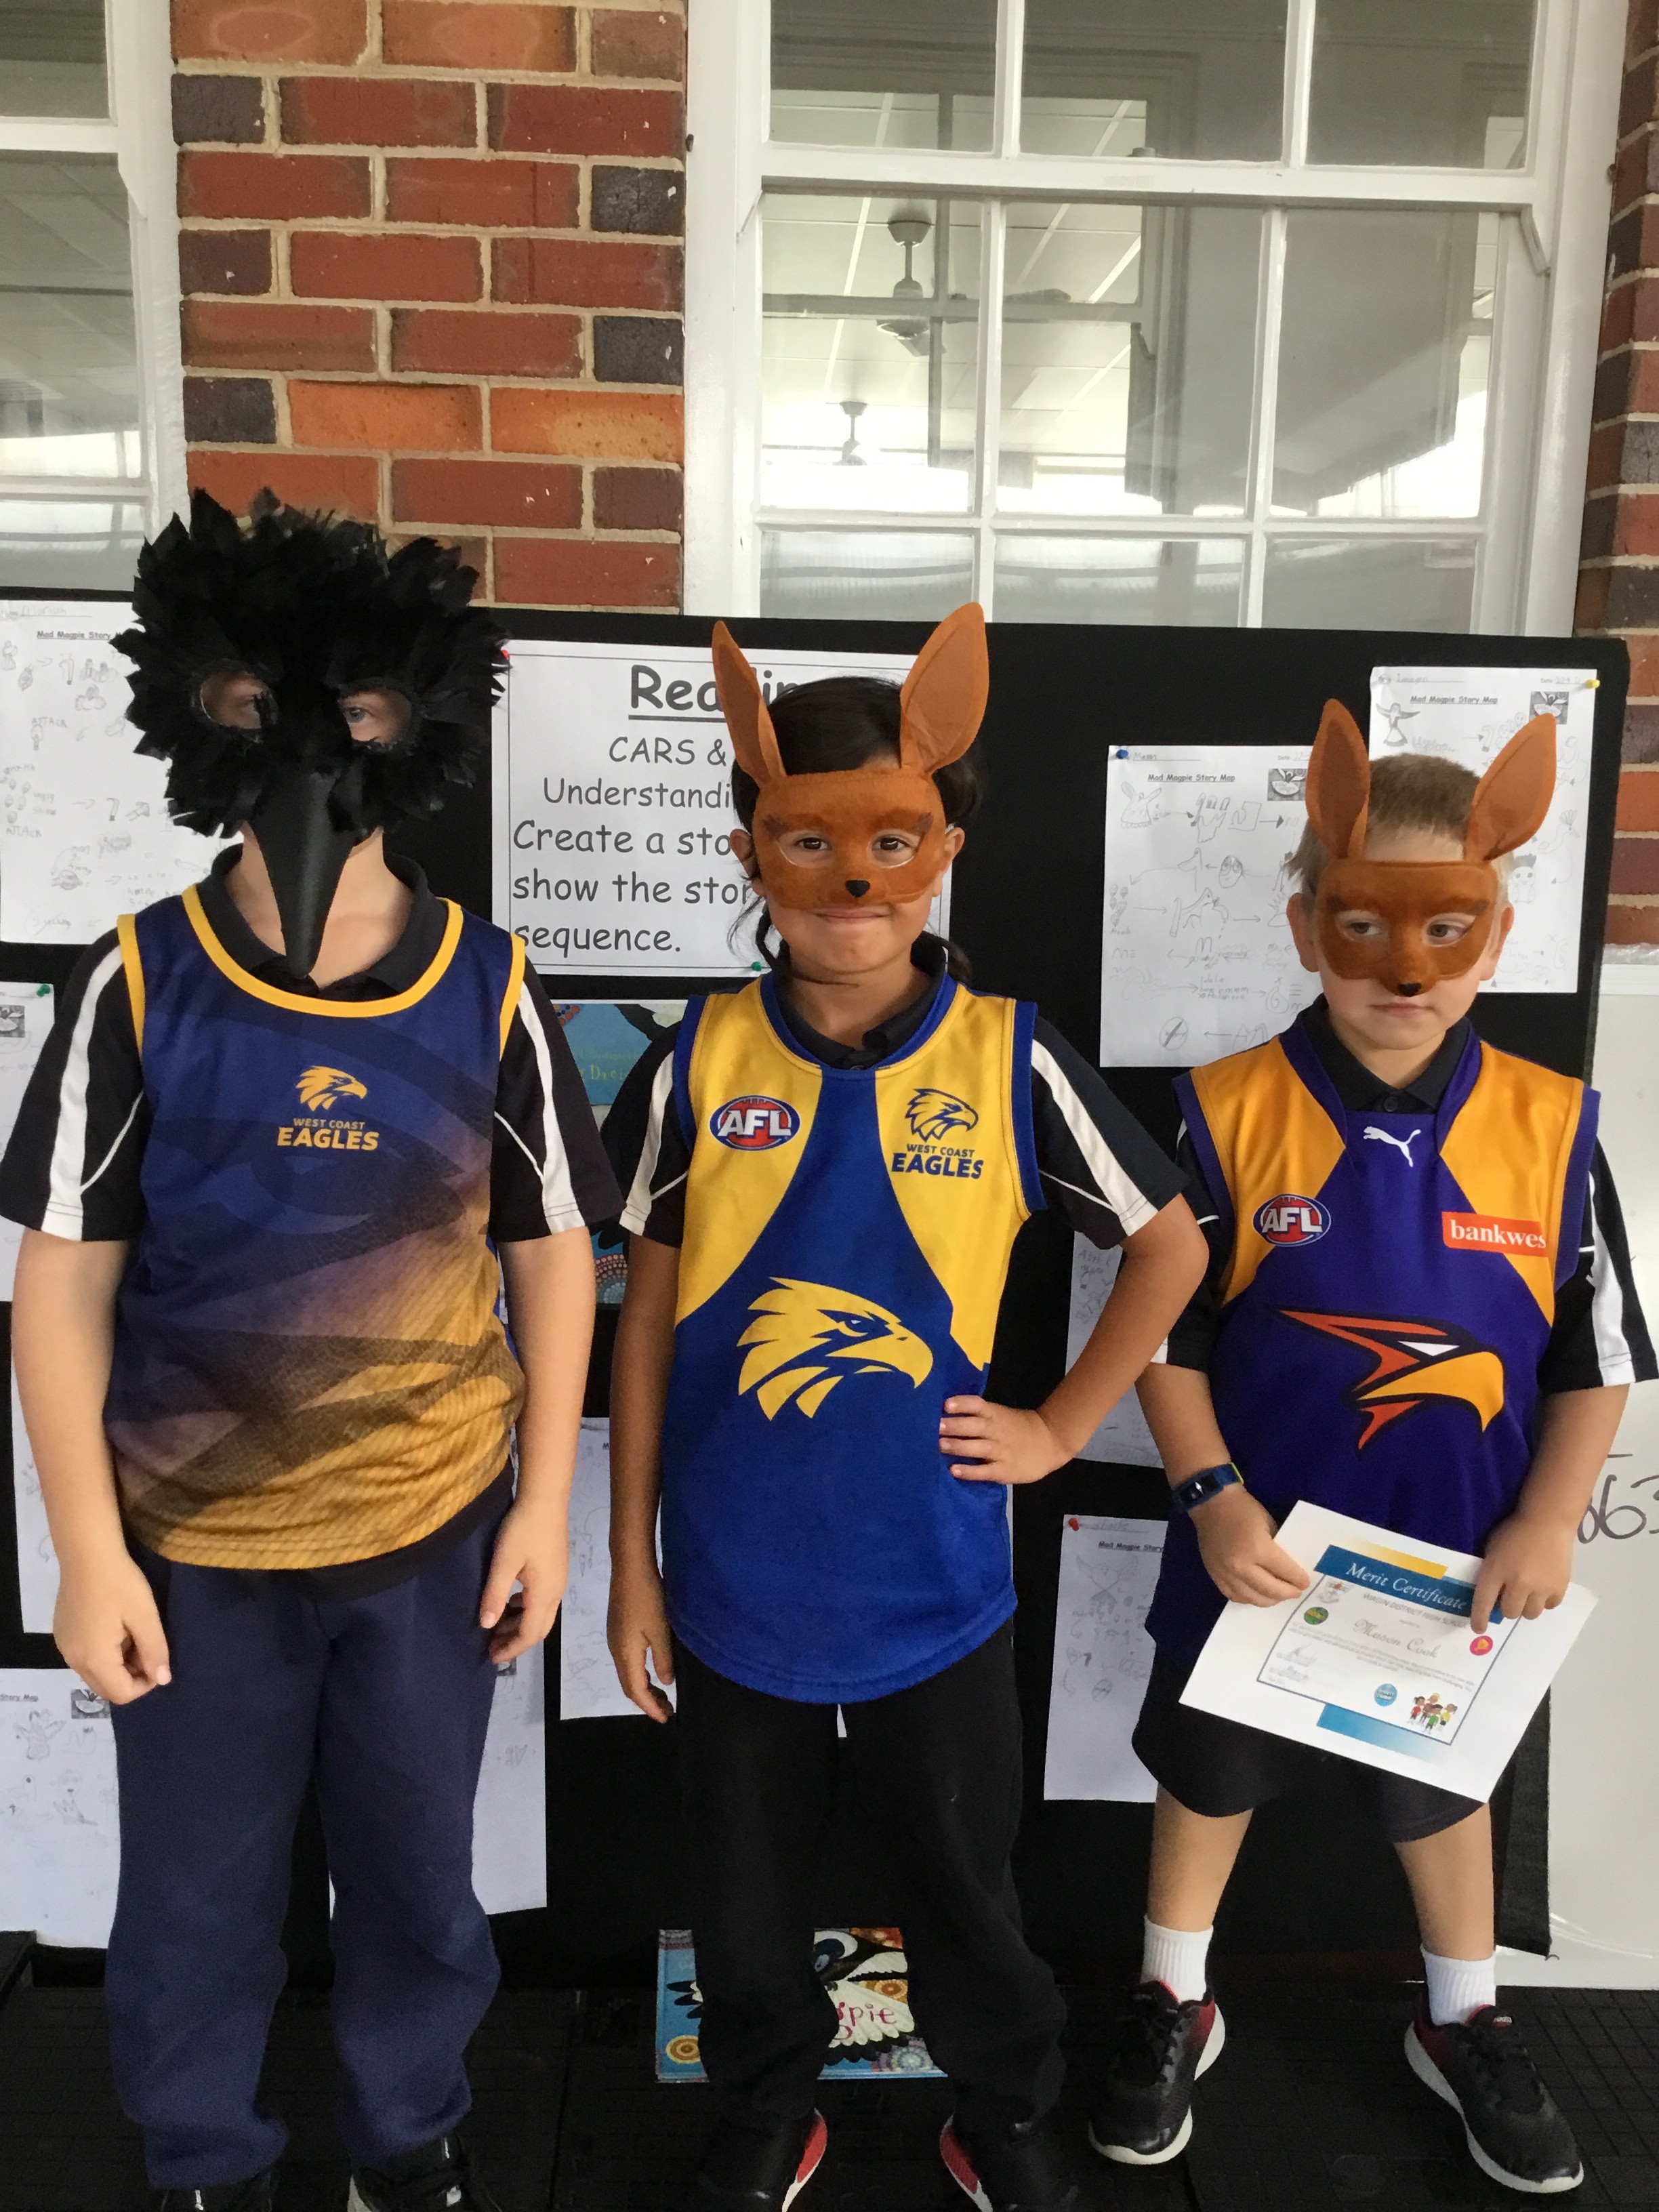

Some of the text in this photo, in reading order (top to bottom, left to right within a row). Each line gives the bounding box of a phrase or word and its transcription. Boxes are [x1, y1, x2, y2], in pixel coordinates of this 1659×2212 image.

[57, 631, 85, 640] Magpie
[89, 632, 110, 640] Story
[1429, 696, 1455, 705] Magpie
[1458, 696, 1479, 705] Story
[1482, 696, 1498, 705] Map
[609, 737, 726, 766] CARS &
[1166, 774, 1192, 783] Magpie
[1195, 774, 1217, 783] Story
[1220, 774, 1235, 783] Map
[544, 777, 731, 808] Understandi
[513, 819, 732, 856] Create a sto
[512, 867, 752, 905] show the stor
[514, 925, 681, 958] sequence.
[293, 1118, 365, 1130] WEST COAST
[717, 1109, 792, 1137] AFL
[276, 1126, 380, 1151] EAGLES
[906, 1143, 975, 1158] WEST COAST
[891, 1152, 984, 1180] EAGLES
[1262, 1207, 1322, 1233] AFL
[1450, 1219, 1546, 1249] bankwes
[1345, 1563, 1467, 1610] Merit Certificate
[1389, 1602, 1420, 1615] DISTRICT
[1406, 1637, 1441, 1658] Cook
